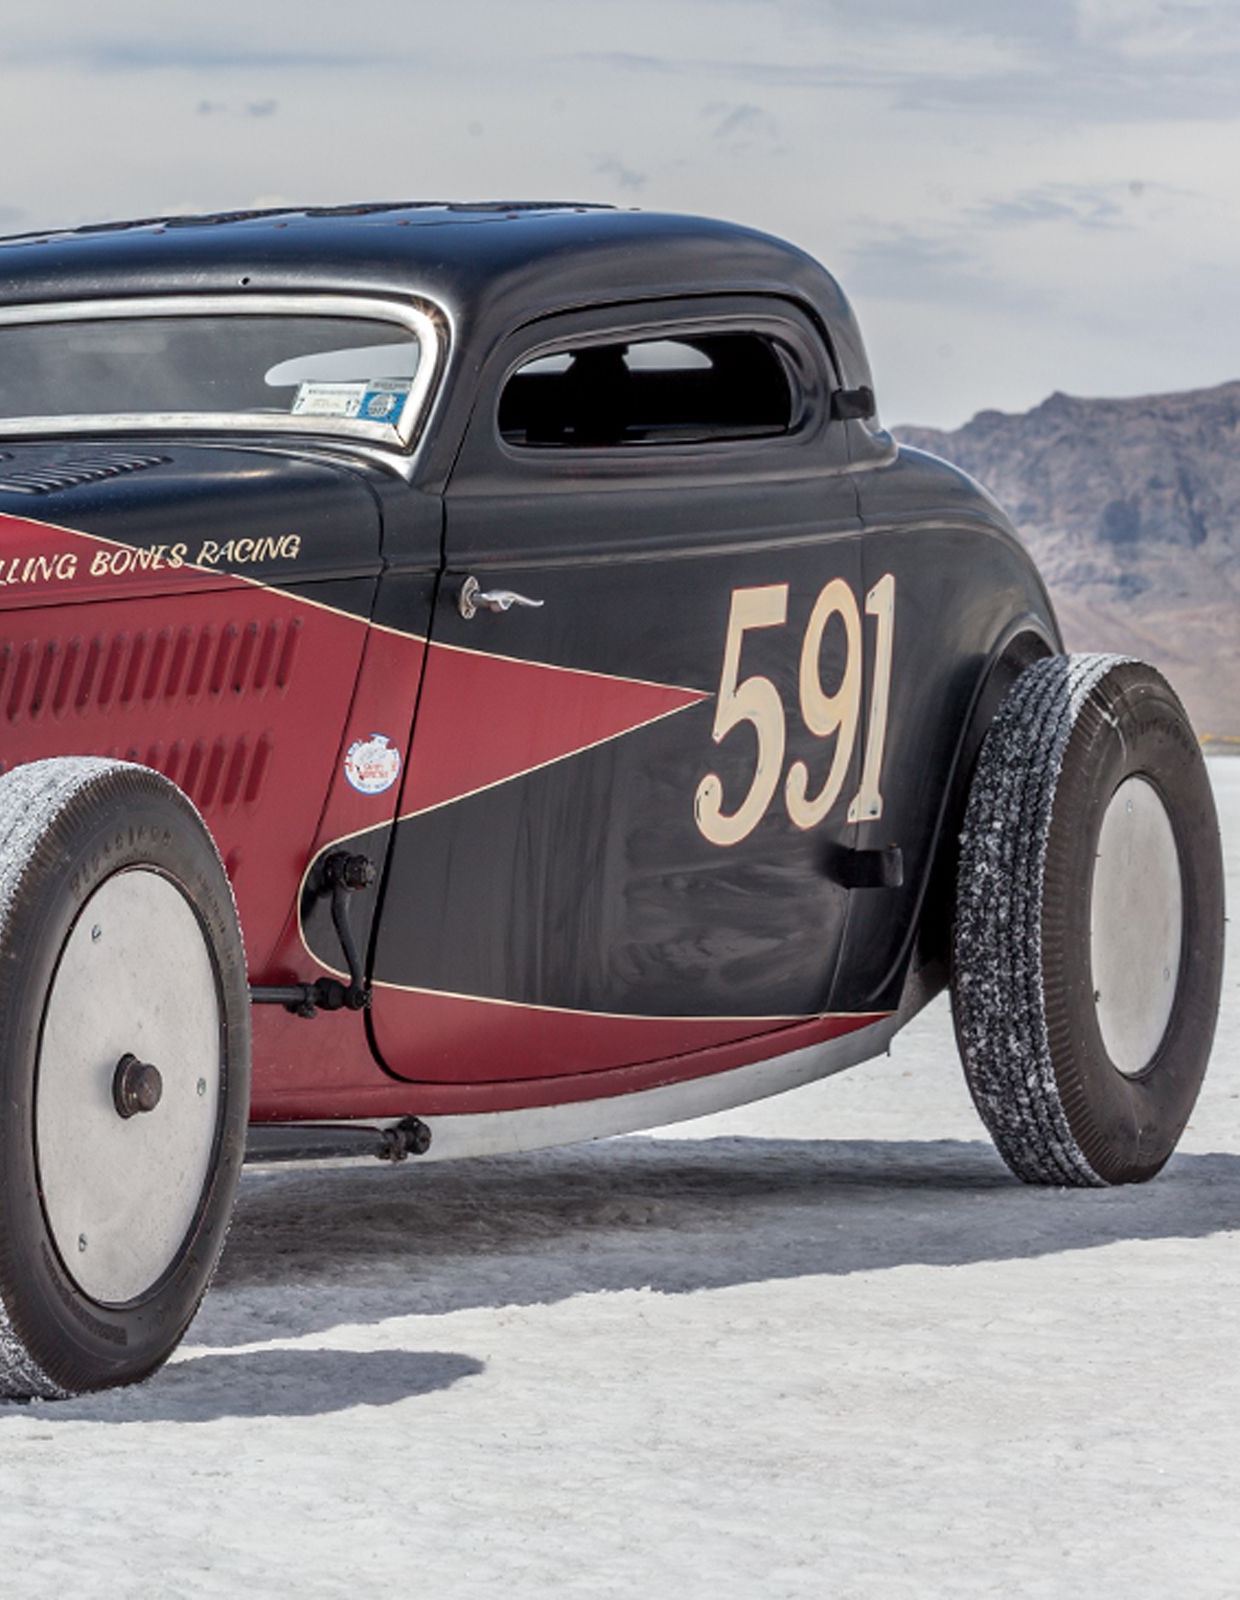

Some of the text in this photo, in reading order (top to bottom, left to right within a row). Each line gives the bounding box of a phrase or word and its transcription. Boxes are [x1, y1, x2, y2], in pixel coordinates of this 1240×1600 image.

[89, 543, 188, 577] BONES
[196, 534, 302, 566] RACING
[694, 571, 896, 847] 591
